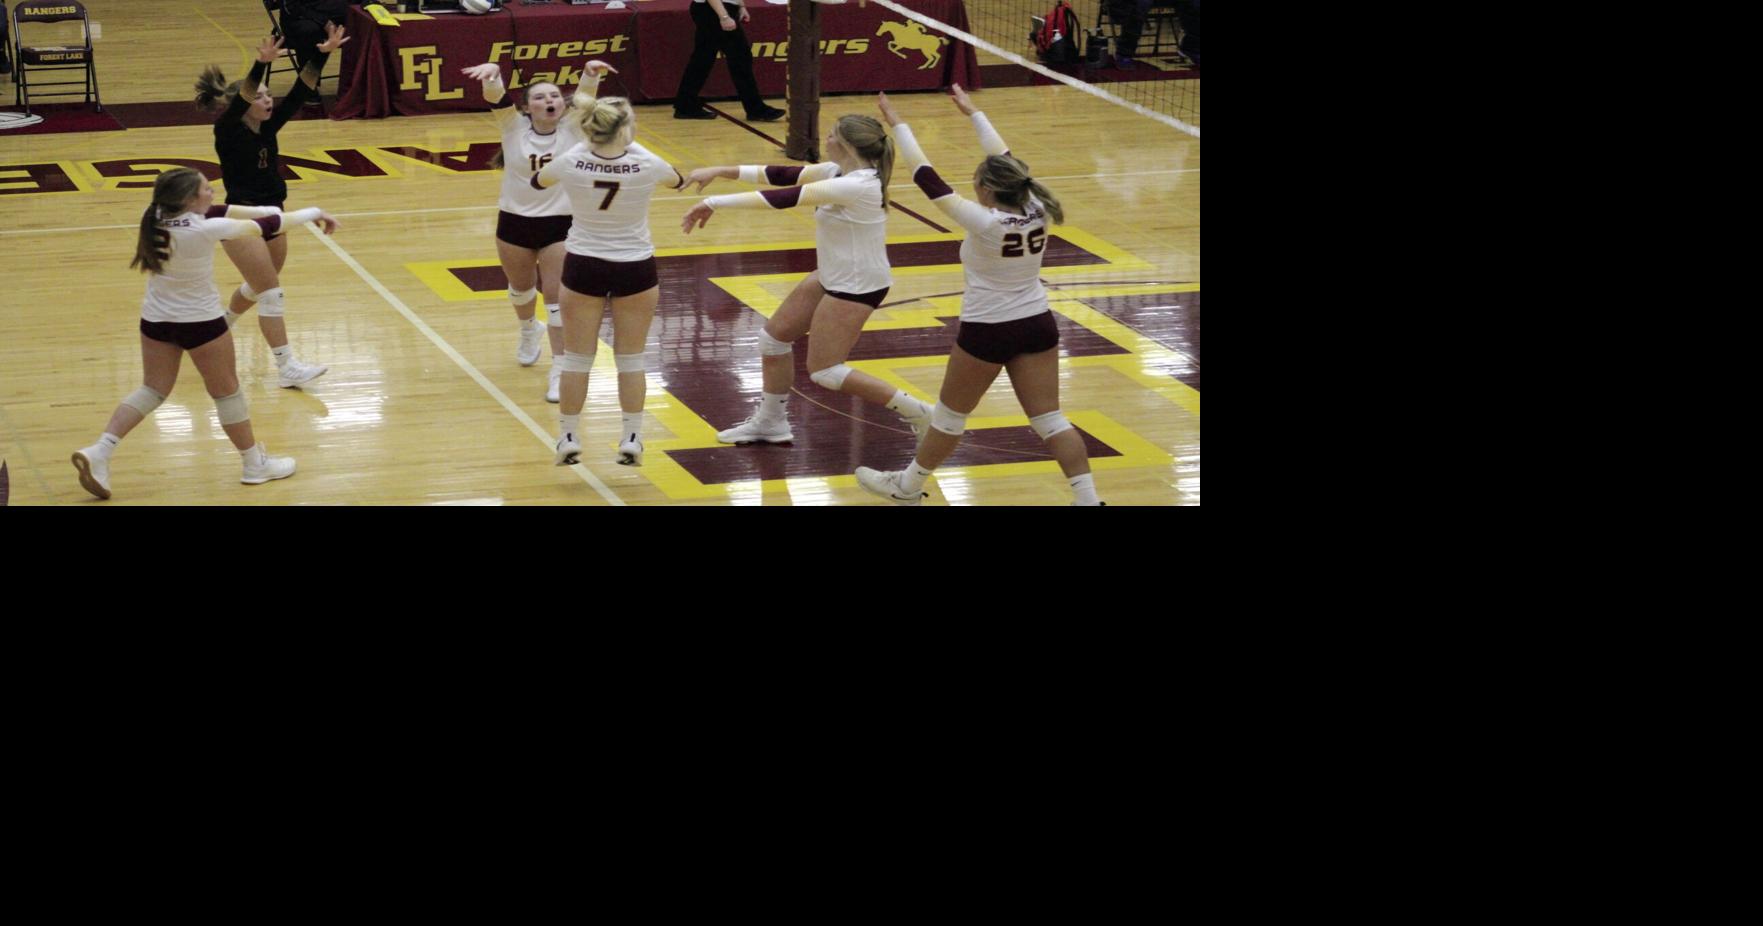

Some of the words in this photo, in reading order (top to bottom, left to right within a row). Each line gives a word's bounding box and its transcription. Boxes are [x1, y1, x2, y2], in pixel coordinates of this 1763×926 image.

[24, 6, 77, 16] RANGERS
[40, 53, 65, 61] FOREST
[66, 52, 84, 60] LAKE
[488, 34, 630, 63] Forest
[398, 45, 464, 101] FL
[575, 160, 641, 175] RANGERS
[593, 180, 620, 211] 7
[1001, 226, 1046, 258] 26
